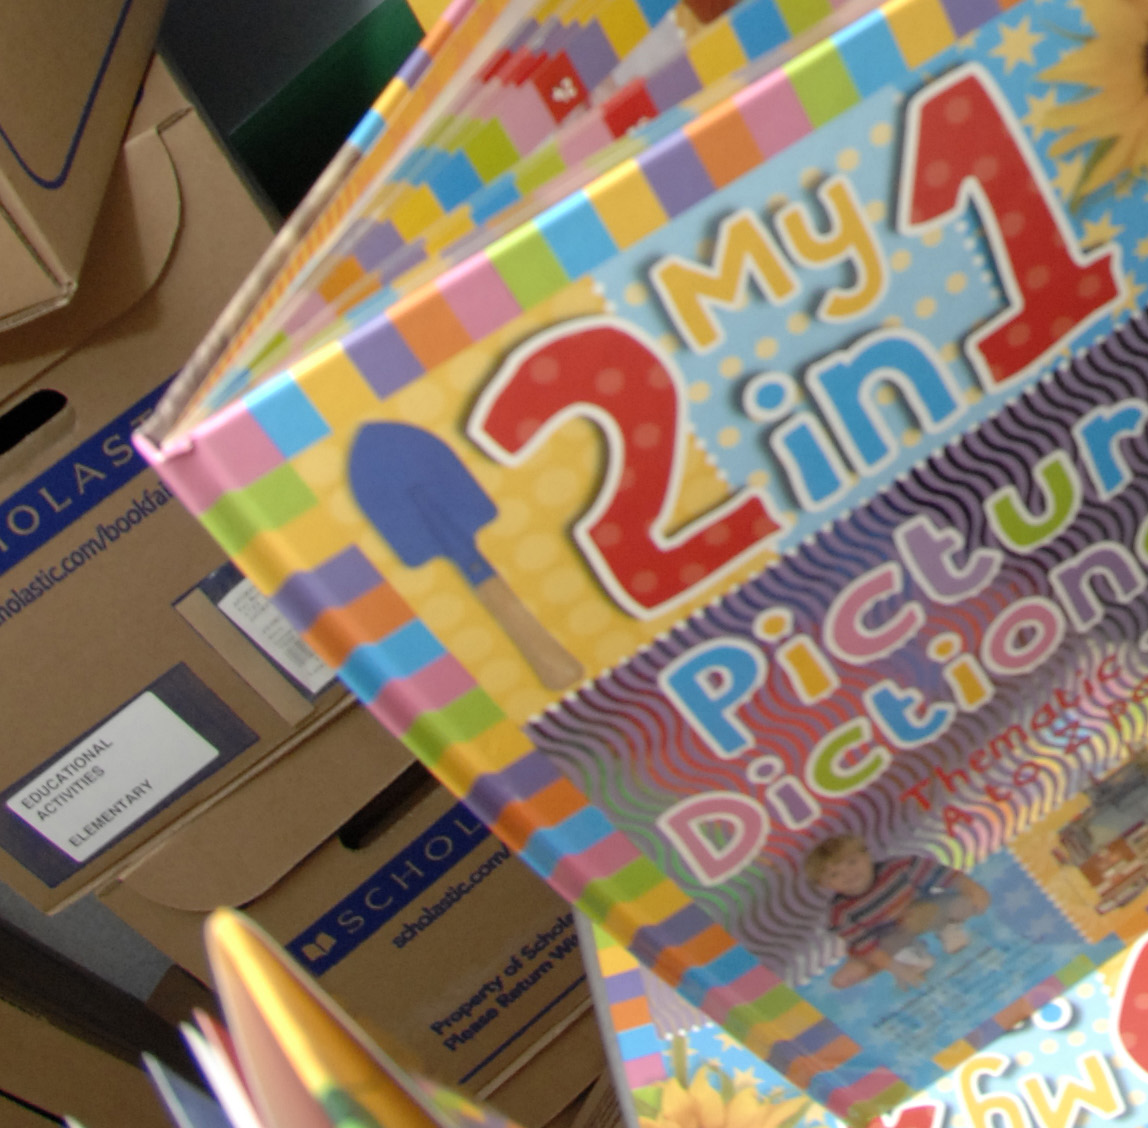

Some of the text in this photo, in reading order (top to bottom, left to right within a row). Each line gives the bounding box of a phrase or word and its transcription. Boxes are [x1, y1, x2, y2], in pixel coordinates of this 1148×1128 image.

[646, 168, 892, 356] My
[463, 59, 1127, 626] 2 in 1
[20, 737, 114, 810] EDUCATIONAL
[900, 653, 1124, 814] Thematic
[36, 765, 105, 821] ACTIVITIES
[68, 779, 154, 848] ELEMENTARY
[941, 801, 976, 838] A
[337, 819, 484, 934] SCHOL
[430, 975, 505, 1035] Property
[503, 955, 524, 977] of
[443, 1007, 500, 1051] Please
[496, 959, 555, 1009] Return
